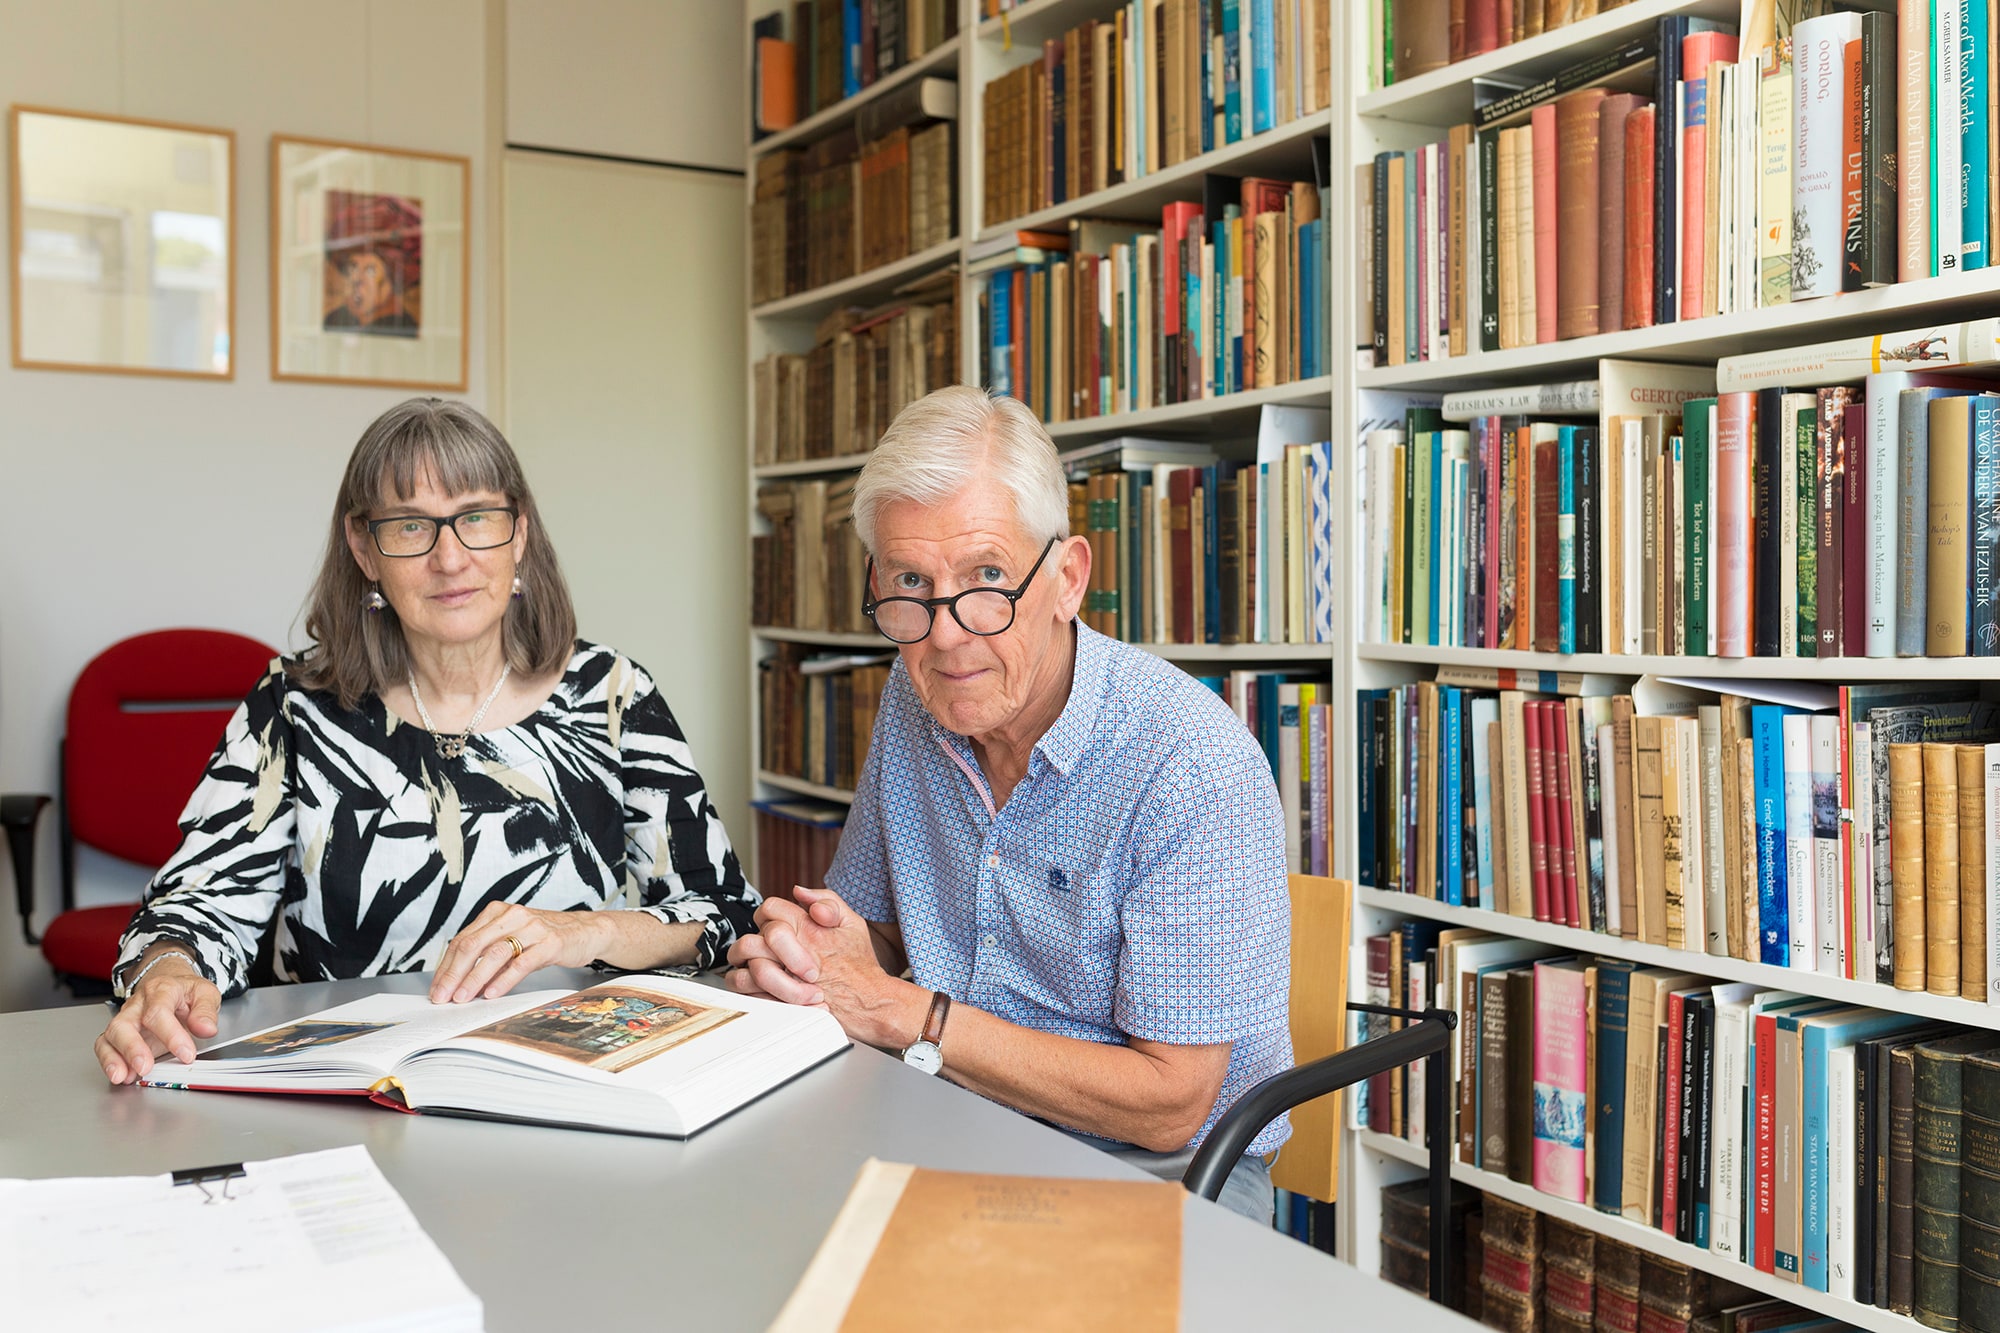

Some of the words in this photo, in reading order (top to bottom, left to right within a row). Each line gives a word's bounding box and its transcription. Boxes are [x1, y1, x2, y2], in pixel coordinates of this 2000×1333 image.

[1961, 26, 1974, 42] of
[1908, 49, 1924, 87] ALVA
[1961, 44, 1974, 78] Two
[1854, 100, 1861, 112] DE
[1908, 91, 1921, 112] EN
[1961, 76, 1974, 136] Worlds
[1908, 116, 1921, 136] DE
[1848, 152, 1862, 182] DE
[1908, 136, 1924, 194] TIENDE
[1848, 190, 1862, 253] PRINS
[1908, 197, 1924, 269] PENNING
[1754, 369, 1781, 380] EIGHTY
[1782, 366, 1805, 374] YEARS
[1446, 397, 1505, 413] GRESHAM'S
[1510, 396, 1531, 408] LAW
[1630, 388, 1674, 404] GEERT
[1976, 410, 1990, 426] DE
[1992, 409, 2000, 455] CRAIG
[1876, 448, 1886, 477] Macht
[1976, 430, 1990, 512] WONDEREN
[1877, 481, 1883, 491] en
[1992, 460, 2000, 523] HARLINE
[1694, 501, 1703, 519] Tot
[1760, 464, 1769, 539] HAHLWEG
[1784, 509, 1791, 518] OF
[1874, 494, 1883, 520] gezag
[1694, 520, 1703, 536] lof
[1876, 524, 1884, 532] in
[1976, 513, 1990, 542] VAN
[1876, 536, 1885, 550] het
[1694, 557, 1703, 601] Haarlem
[1875, 553, 1885, 605] Markiezaat
[1976, 546, 1990, 608] JEZUS-EIK
[1924, 713, 1971, 727] Frontierstad
[1708, 746, 1716, 763] The
[1708, 767, 1717, 794] World
[1763, 756, 1771, 788] Hofman
[1650, 810, 1659, 820] 2
[1709, 796, 1718, 807] of
[1764, 799, 1774, 828] Eenich
[1710, 808, 1719, 847] William
[1710, 848, 1719, 867] and
[1766, 829, 1776, 896] Achterdencken
[1788, 839, 1799, 877] HOLLAND
[1820, 840, 1830, 878] HOLLAND
[1710, 869, 1720, 895] Mary
[1796, 851, 1807, 907] GESCHIEDENIS
[1827, 852, 1837, 908] GESCHIEDENIS
[1672, 1000, 1680, 1023] Geert
[1684, 1013, 1694, 1040] Princely
[1670, 1038, 1678, 1070] Janssen
[1685, 1074, 1693, 1085] the
[1686, 1064, 1693, 1072] in
[1668, 1075, 1676, 1129] CREATUREN
[1684, 1086, 1692, 1107] Dutch
[1682, 1108, 1692, 1138] Republic
[1760, 1094, 1769, 1141] VIEREN
[1667, 1152, 1675, 1165] DE
[1760, 1146, 1769, 1168] VAN
[1858, 1154, 1865, 1164] DE
[1666, 1168, 1674, 1200] MACHT
[1810, 1168, 1818, 1188] VAN
[1760, 1174, 1769, 1214] VREDE
